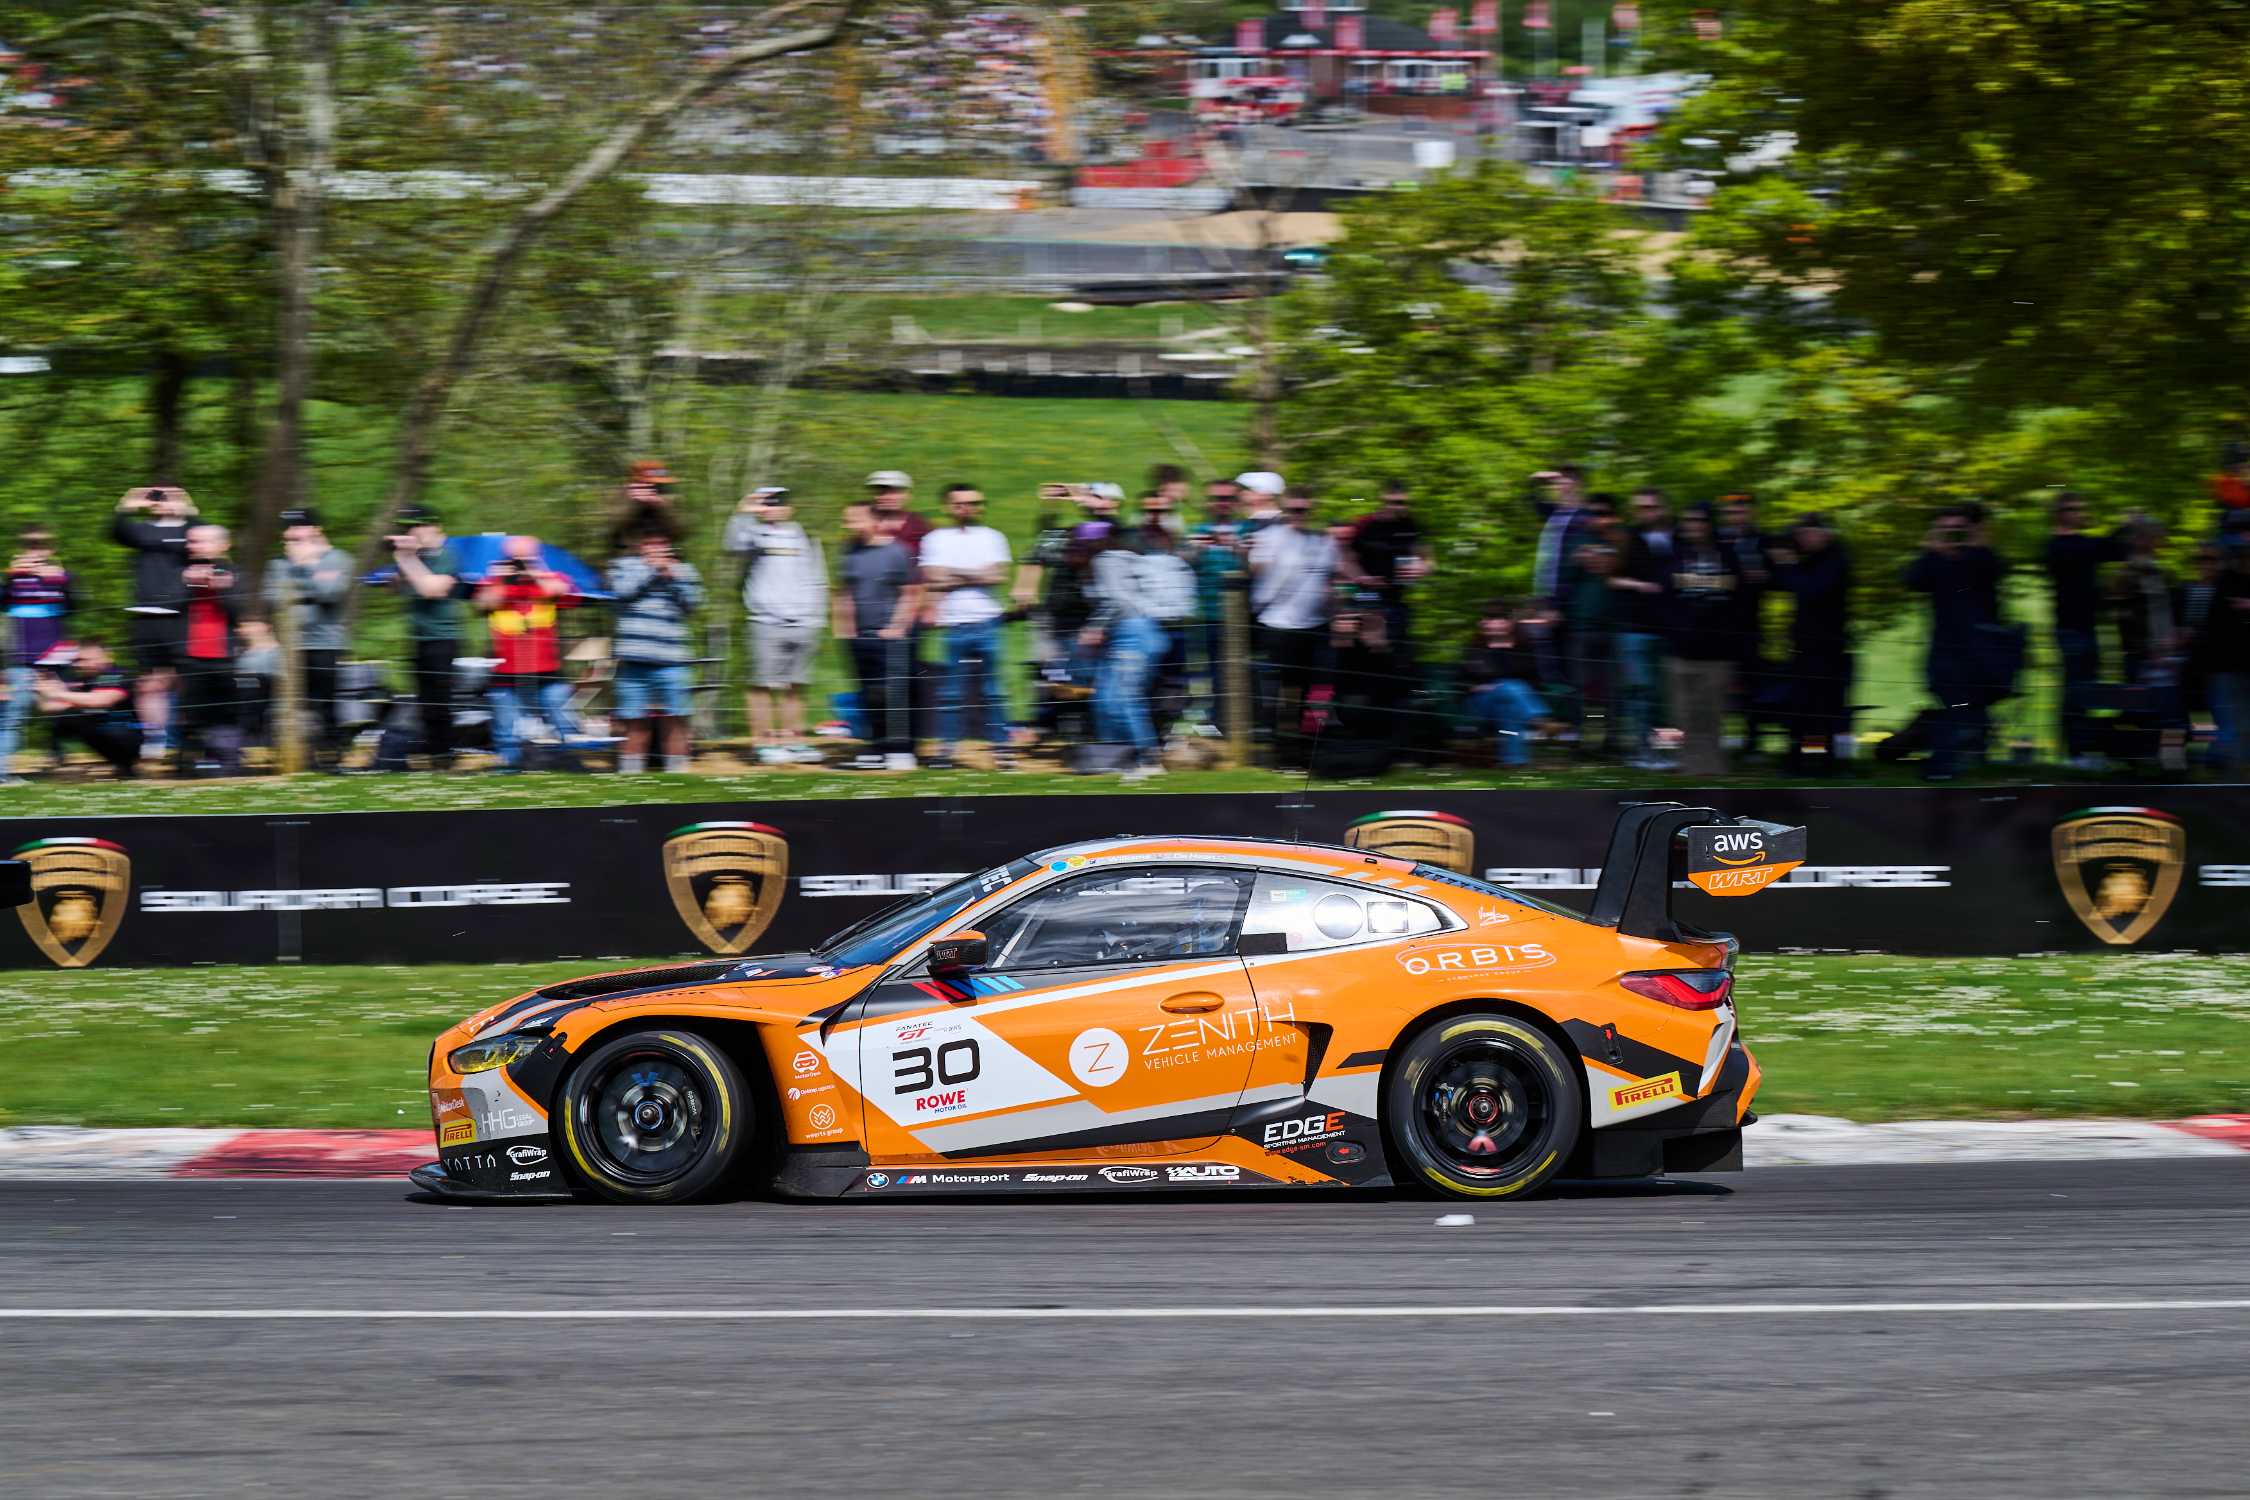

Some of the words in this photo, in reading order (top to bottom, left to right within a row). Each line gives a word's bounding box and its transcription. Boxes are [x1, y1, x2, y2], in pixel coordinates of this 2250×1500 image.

[1714, 832, 1763, 852] aws
[1709, 867, 1773, 889] WRT
[1404, 944, 1547, 975] ORBIS
[1138, 1002, 1297, 1056] ZENITH
[1083, 1042, 1114, 1073] Z
[1144, 1052, 1200, 1070] VEHICLE
[1206, 1033, 1297, 1060] MANAGEMENT
[892, 1038, 980, 1095] 30
[916, 1090, 966, 1111] ROWE
[1614, 1078, 1674, 1106] PIRELLI
[934, 1105, 956, 1114] MOTOR
[481, 1108, 517, 1134] HHG
[1264, 1111, 1346, 1142] EDGE
[443, 1123, 472, 1142] PIRELLI
[1263, 1139, 1297, 1150] SPORTING
[1298, 1130, 1346, 1143] MANAGEMENT
[509, 1149, 547, 1159] GrafiWrap
[510, 1170, 550, 1181] Snap-on
[933, 1173, 1010, 1184] Motorsport
[1022, 1173, 1088, 1183] Snap-on
[1105, 1168, 1158, 1178] GrafiWrap
